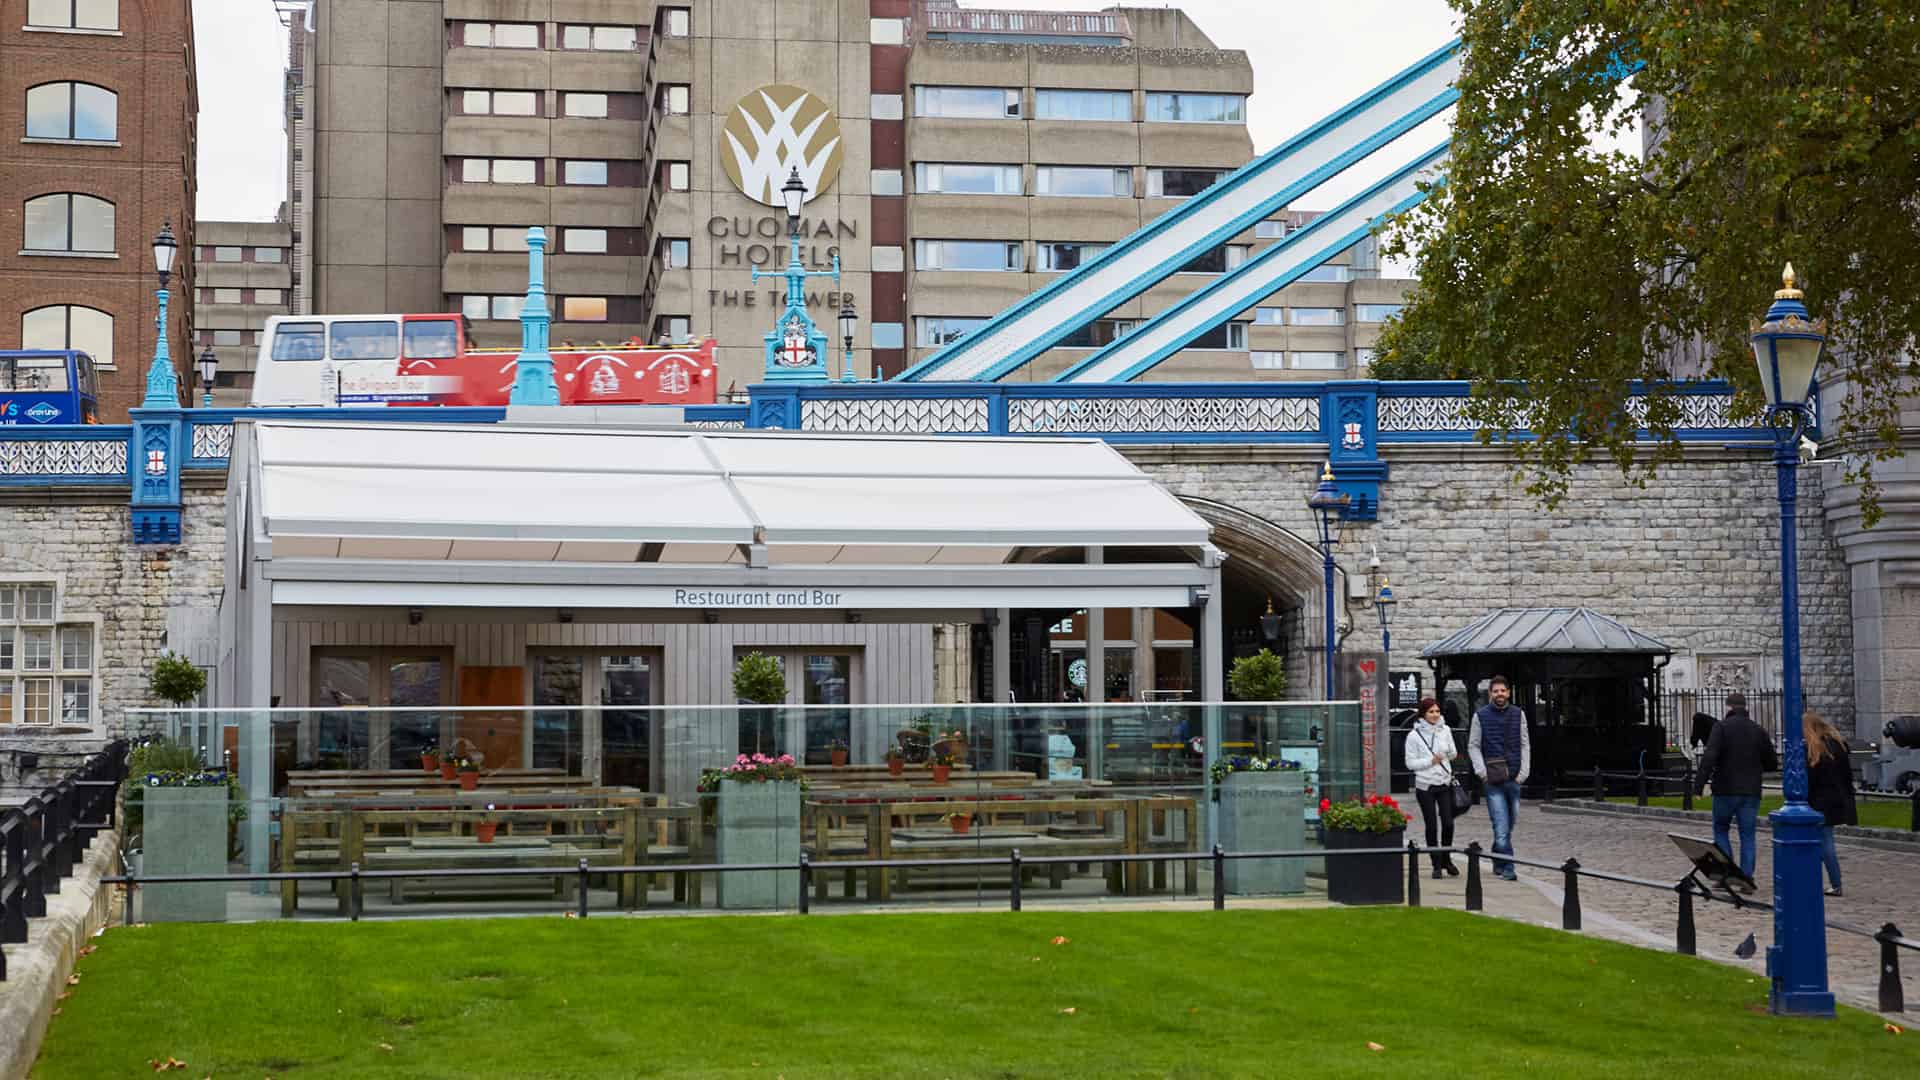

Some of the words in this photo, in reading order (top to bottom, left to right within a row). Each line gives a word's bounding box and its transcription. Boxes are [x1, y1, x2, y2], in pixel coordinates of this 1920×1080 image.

[707, 215, 857, 239] GUOMAN
[721, 244, 841, 266] HOTELS
[708, 290, 756, 307] THE
[675, 589, 771, 605] Restaurant
[776, 590, 807, 605] and
[813, 590, 841, 605] Bar
